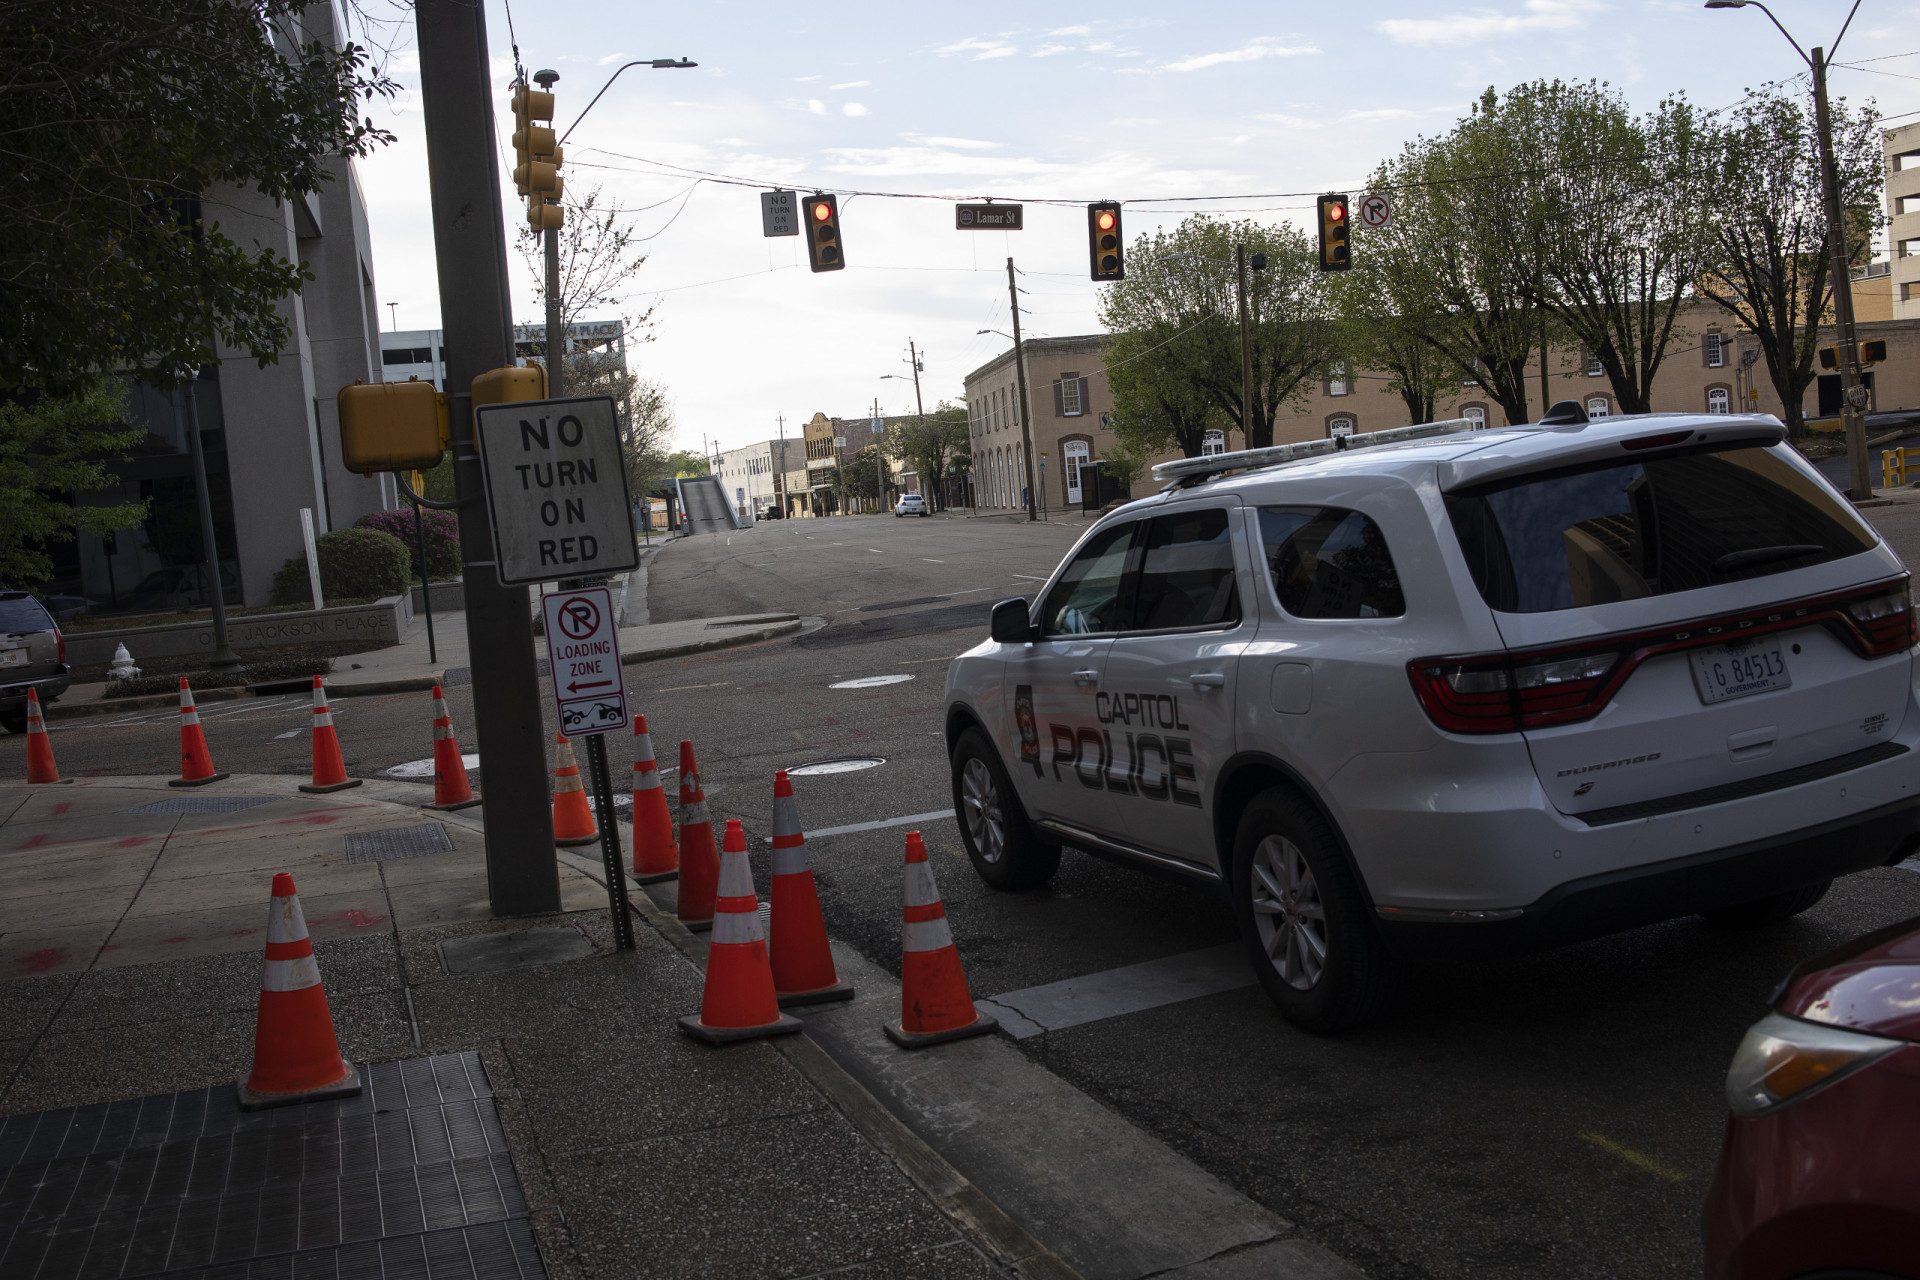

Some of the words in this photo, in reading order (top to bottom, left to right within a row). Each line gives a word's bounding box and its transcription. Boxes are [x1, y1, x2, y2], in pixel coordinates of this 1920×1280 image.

[769, 206, 790, 214] TURN
[771, 196, 787, 205] NO
[773, 225, 789, 233] RED
[775, 215, 786, 223] ON
[976, 210, 1004, 224] Lamar
[1006, 210, 1015, 224] St
[1850, 388, 1863, 397] ONE
[519, 414, 584, 452] NO
[515, 458, 598, 490] TURN
[540, 498, 586, 527] ON
[539, 535, 598, 566] RED
[199, 630, 234, 646] OE
[245, 621, 325, 641] JACKSON
[335, 614, 389, 632] PLACE
[1676, 608, 1808, 640] DODGE
[556, 640, 611, 661] LOADING
[570, 660, 603, 678] ZONE
[1713, 663, 1726, 686] G
[1731, 650, 1784, 683] 84513
[1725, 679, 1769, 694] GOVERNMENT
[1096, 691, 1190, 731] CAPITOL
[1049, 722, 1203, 809] POLICE
[1557, 751, 1662, 778] DURANGO
